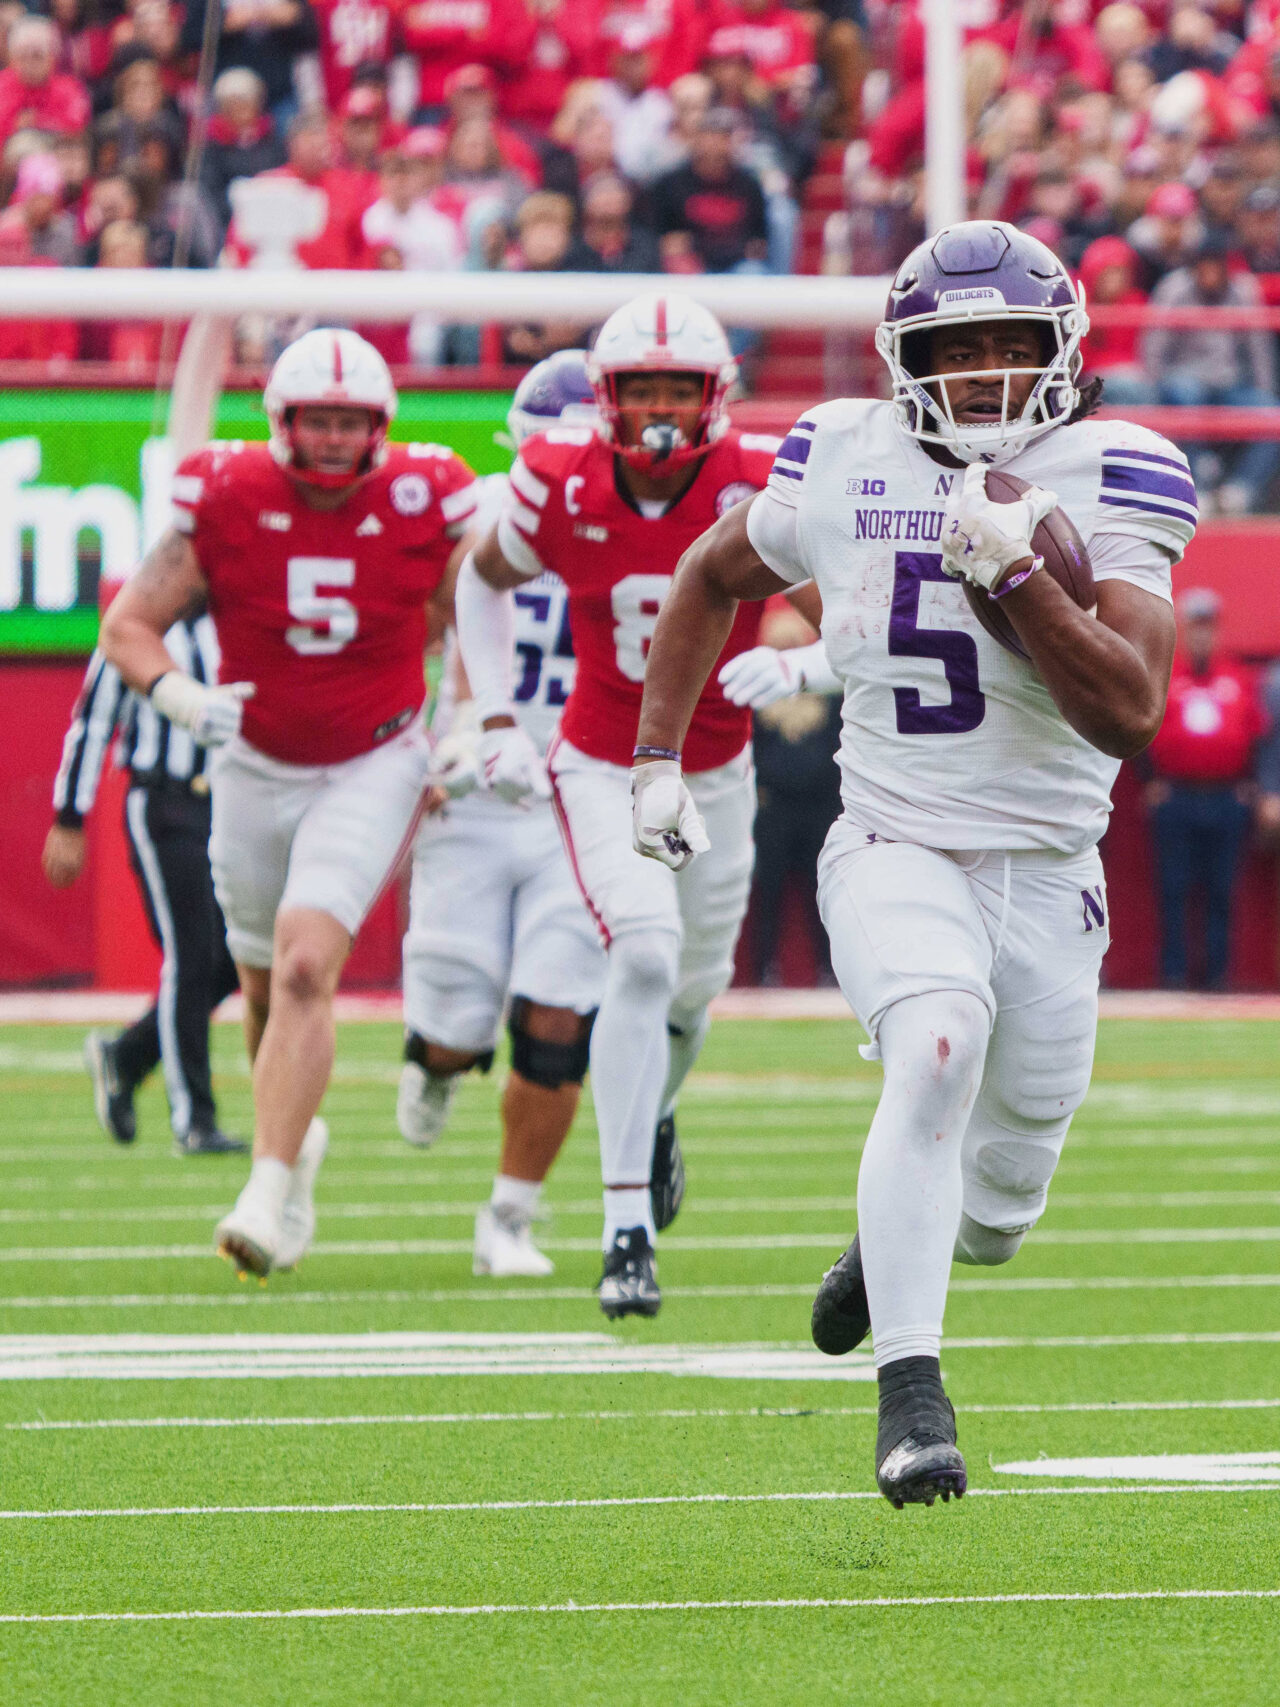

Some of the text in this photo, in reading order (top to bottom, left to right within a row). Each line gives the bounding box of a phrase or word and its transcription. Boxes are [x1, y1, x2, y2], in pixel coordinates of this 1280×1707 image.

[945, 289, 994, 303] WILDCATS
[565, 474, 585, 516] C
[934, 474, 955, 496] N
[855, 509, 947, 542] NORTHW
[285, 556, 359, 655] 5
[611, 573, 675, 683] 8
[888, 551, 985, 734] 5
[1080, 885, 1105, 932] N
